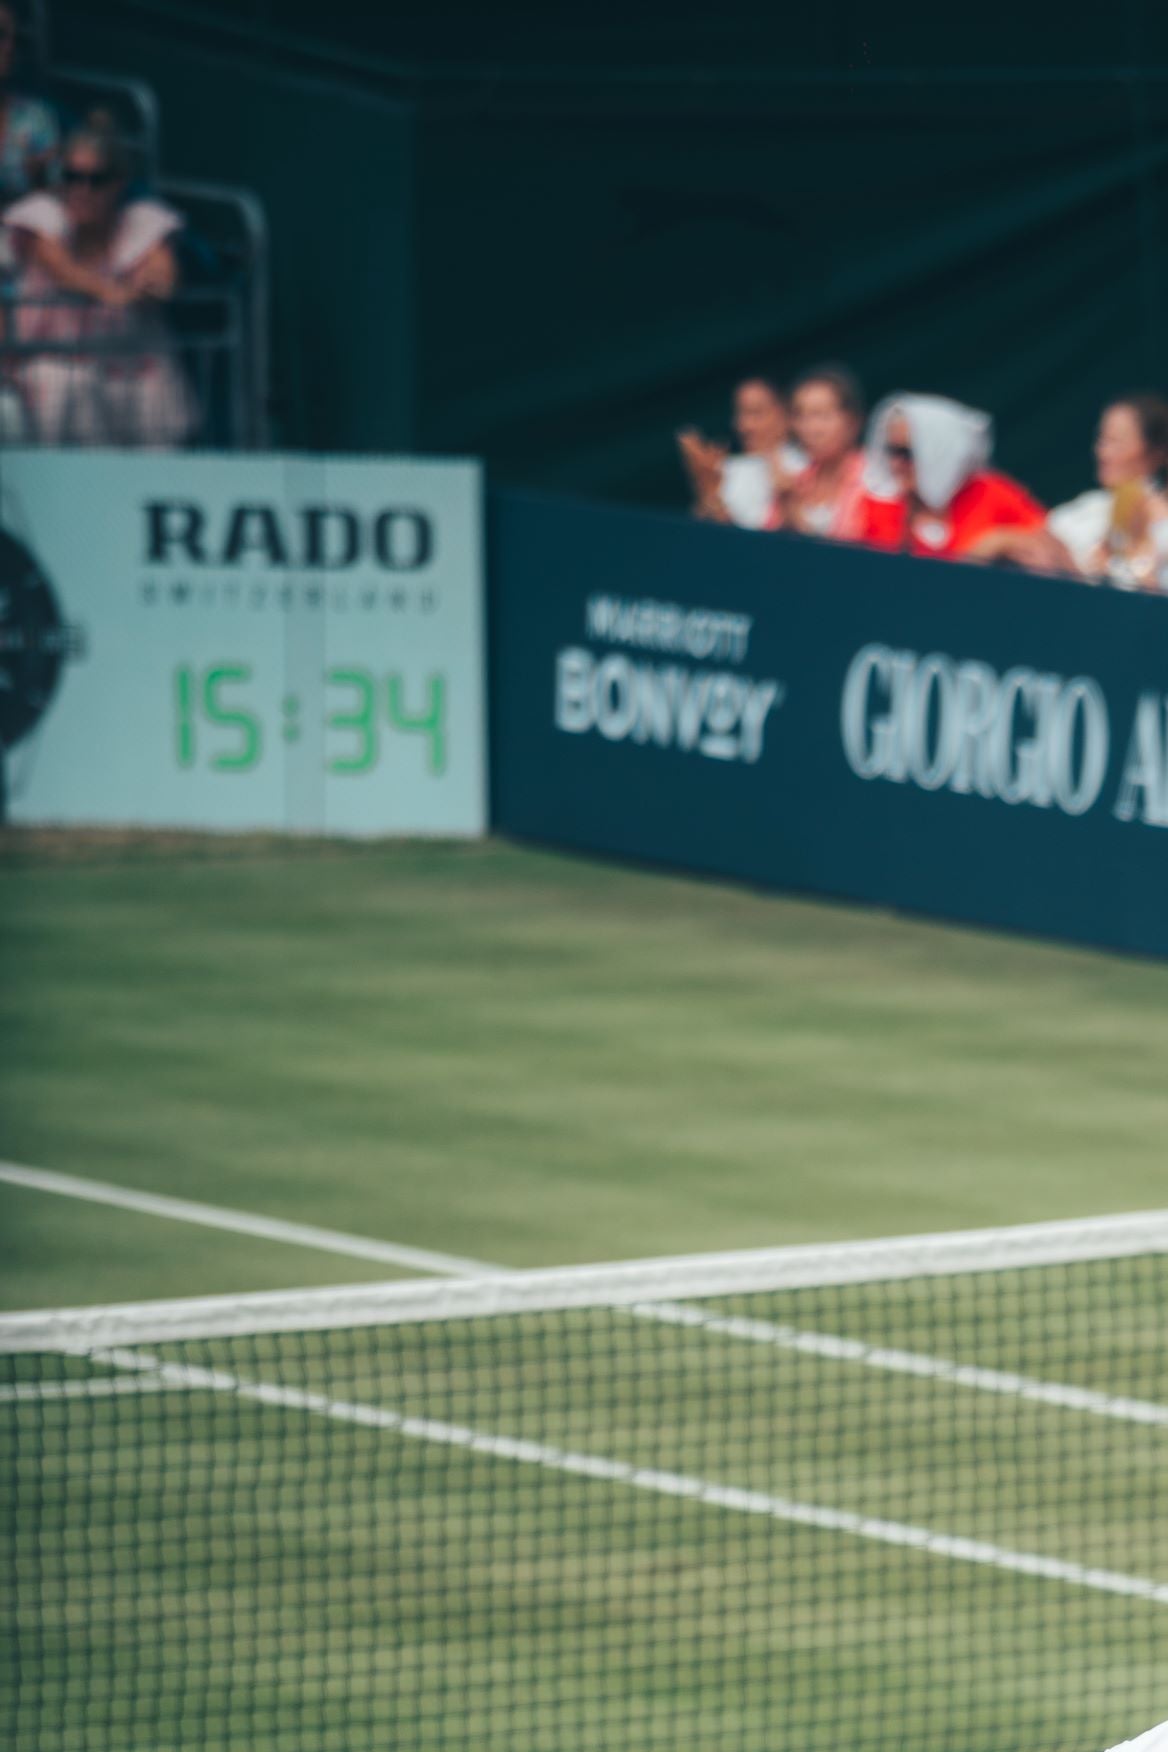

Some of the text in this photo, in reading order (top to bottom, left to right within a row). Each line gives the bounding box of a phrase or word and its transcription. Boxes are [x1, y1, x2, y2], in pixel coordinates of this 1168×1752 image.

[144, 499, 434, 569] RADO
[175, 664, 445, 773] 15:34
[555, 645, 784, 764] BONVOY
[840, 642, 1109, 816] GIORGIO
